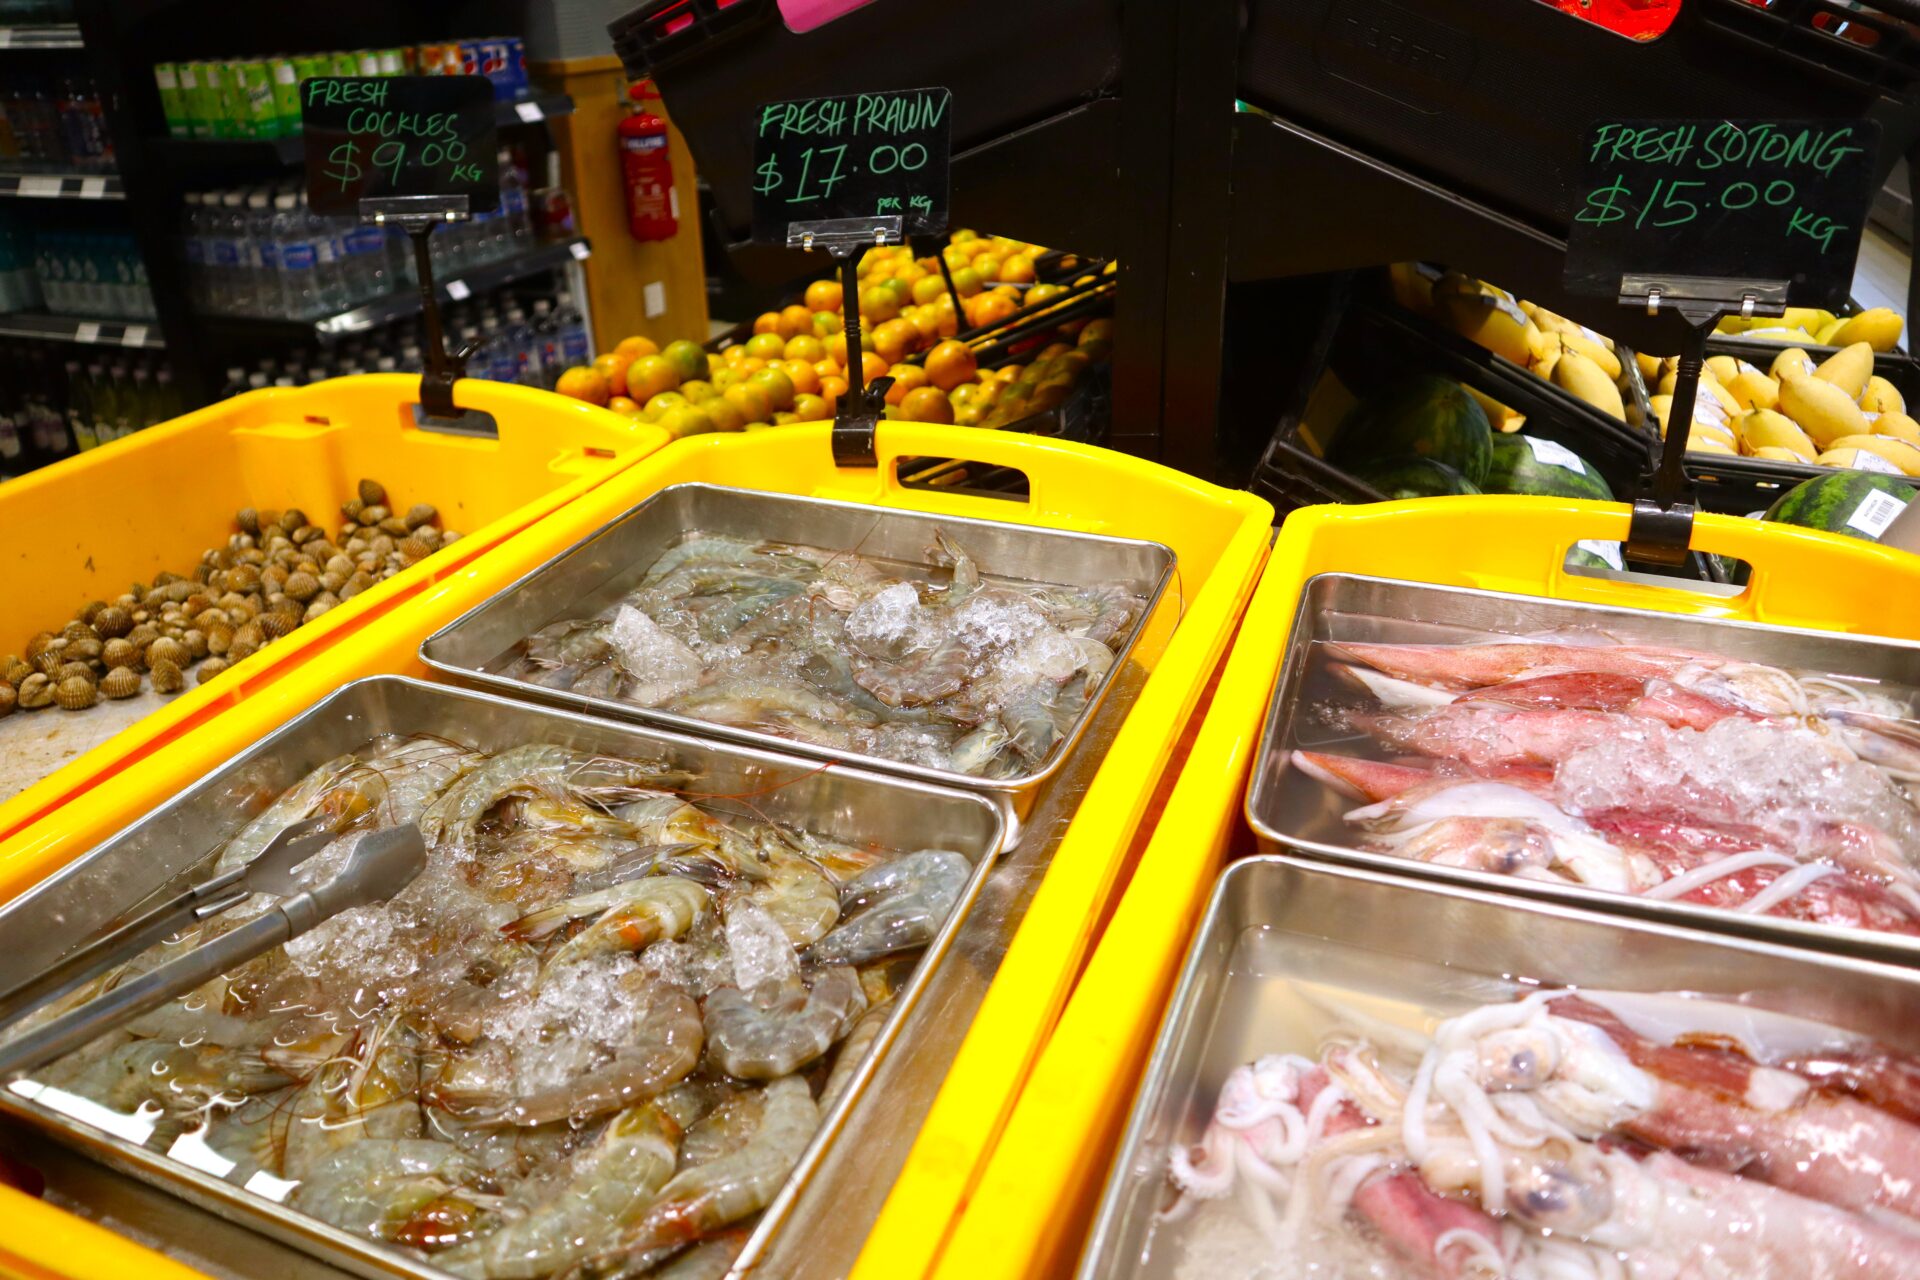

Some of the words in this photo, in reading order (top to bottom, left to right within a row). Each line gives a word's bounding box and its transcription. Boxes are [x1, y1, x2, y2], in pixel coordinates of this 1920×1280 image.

[308, 80, 389, 107] FRESH
[347, 107, 458, 142] COCKLES
[760, 100, 847, 139] FRESH
[853, 92, 949, 136] PRAWN
[1590, 124, 1696, 166] FRESH
[1697, 124, 1863, 178] SOTONG
[450, 163, 482, 183] KG
[877, 197, 902, 215] PER
[910, 195, 933, 216] KG
[1575, 174, 1795, 229] $15.00
[1786, 207, 1848, 254] KG
